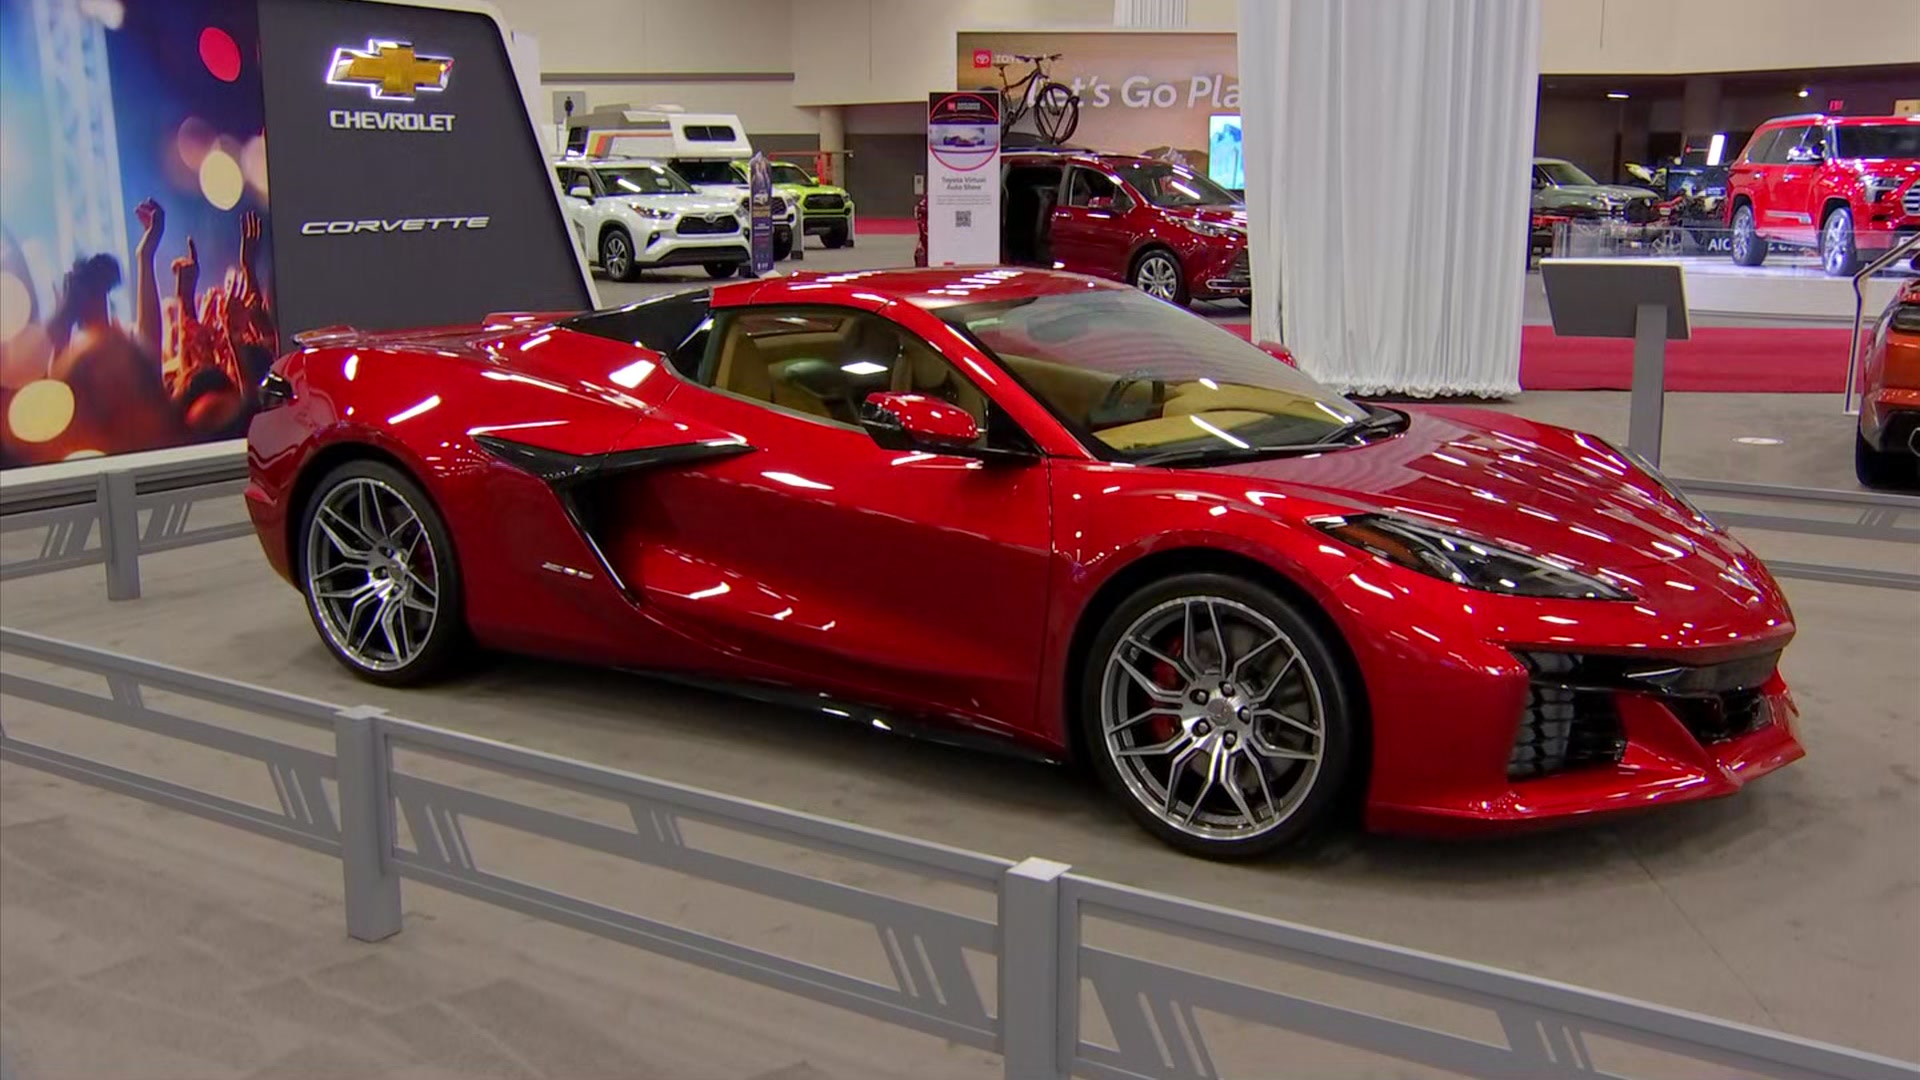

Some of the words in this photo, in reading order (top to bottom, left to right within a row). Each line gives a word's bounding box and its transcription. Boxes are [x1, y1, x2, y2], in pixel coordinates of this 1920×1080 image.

[1121, 75, 1177, 108] Go
[330, 110, 455, 131] CHEVROLET
[942, 176, 963, 184] Toyota
[302, 216, 490, 234] CORVETTE
